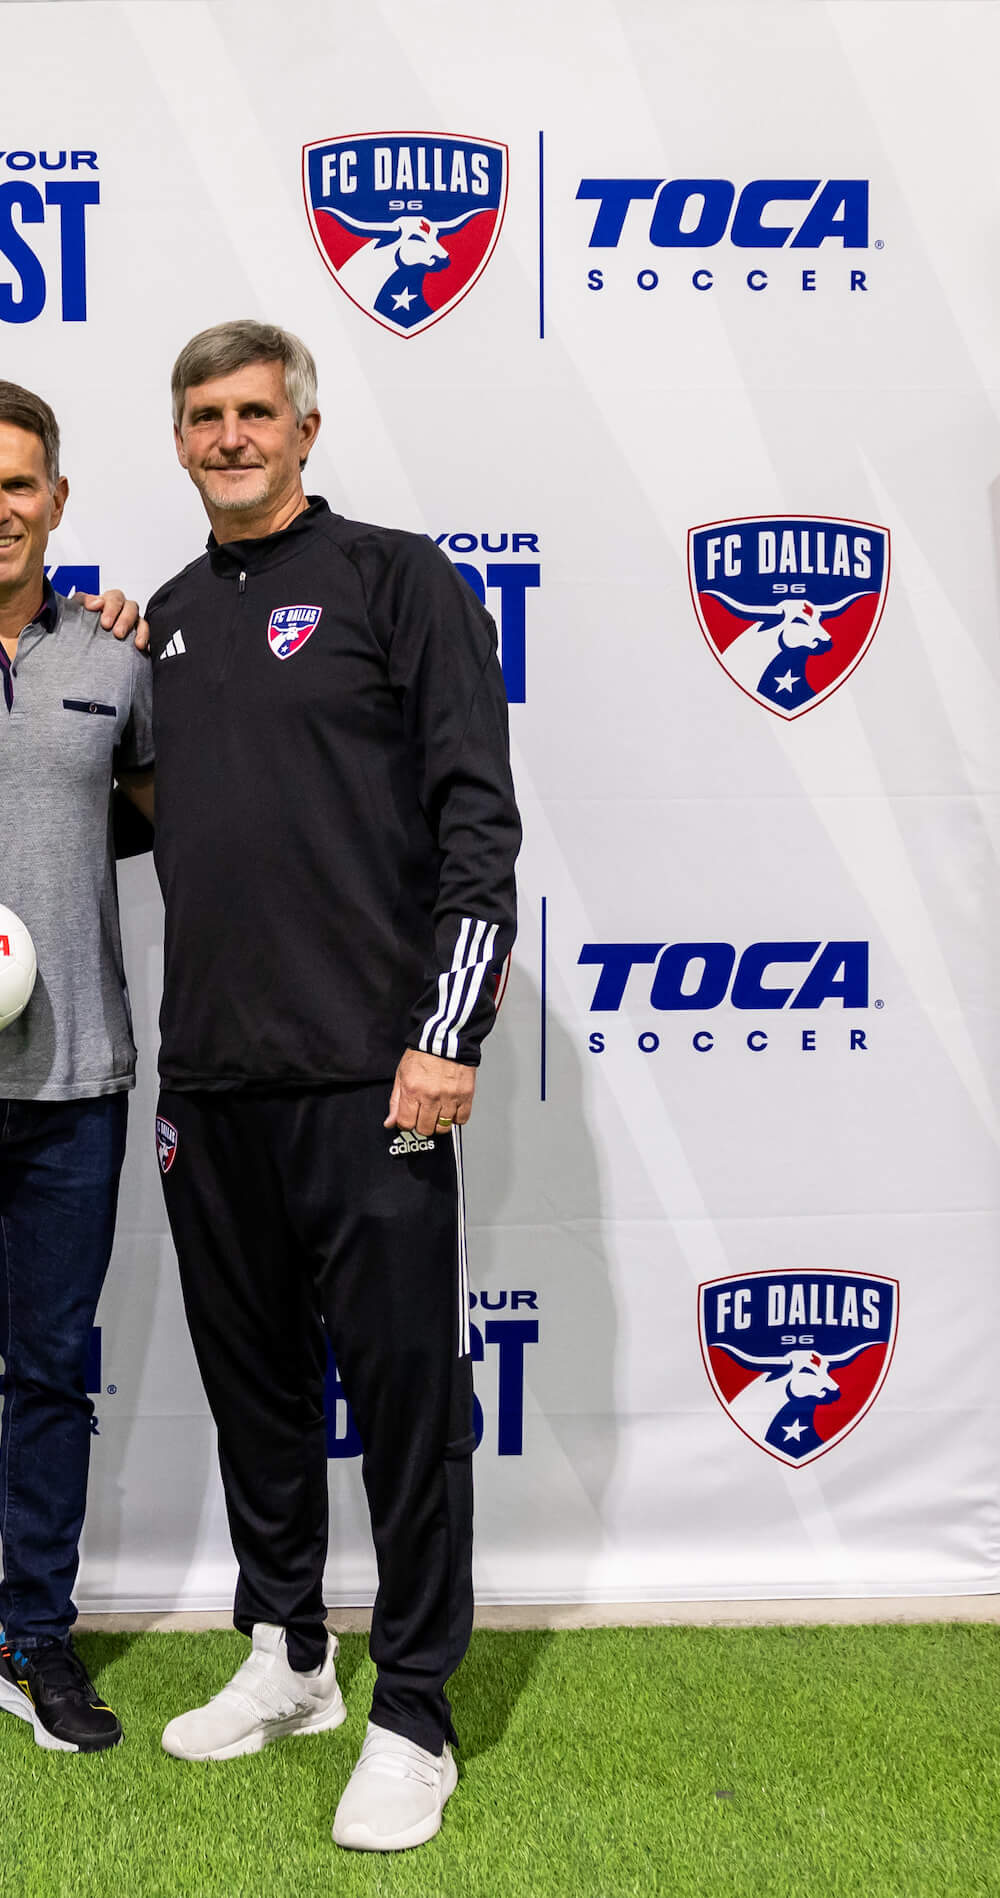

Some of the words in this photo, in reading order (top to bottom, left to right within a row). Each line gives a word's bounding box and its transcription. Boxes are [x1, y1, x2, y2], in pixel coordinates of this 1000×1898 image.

[322, 151, 357, 196] FC
[375, 147, 488, 195] DALLAS
[389, 201, 422, 210] 96
[576, 179, 869, 248] TOCA
[588, 270, 867, 291] SOCCER
[707, 534, 741, 580] FC
[759, 531, 871, 578] DALLAS
[773, 584, 805, 593] 96
[286, 609, 317, 622] DALLAS
[577, 941, 868, 1011] TOCA
[589, 1030, 867, 1053] SOCCER
[389, 1140, 435, 1155] adidas
[717, 1289, 751, 1333] FC
[768, 1284, 879, 1329] DALLAS
[782, 1335, 813, 1344] 96
